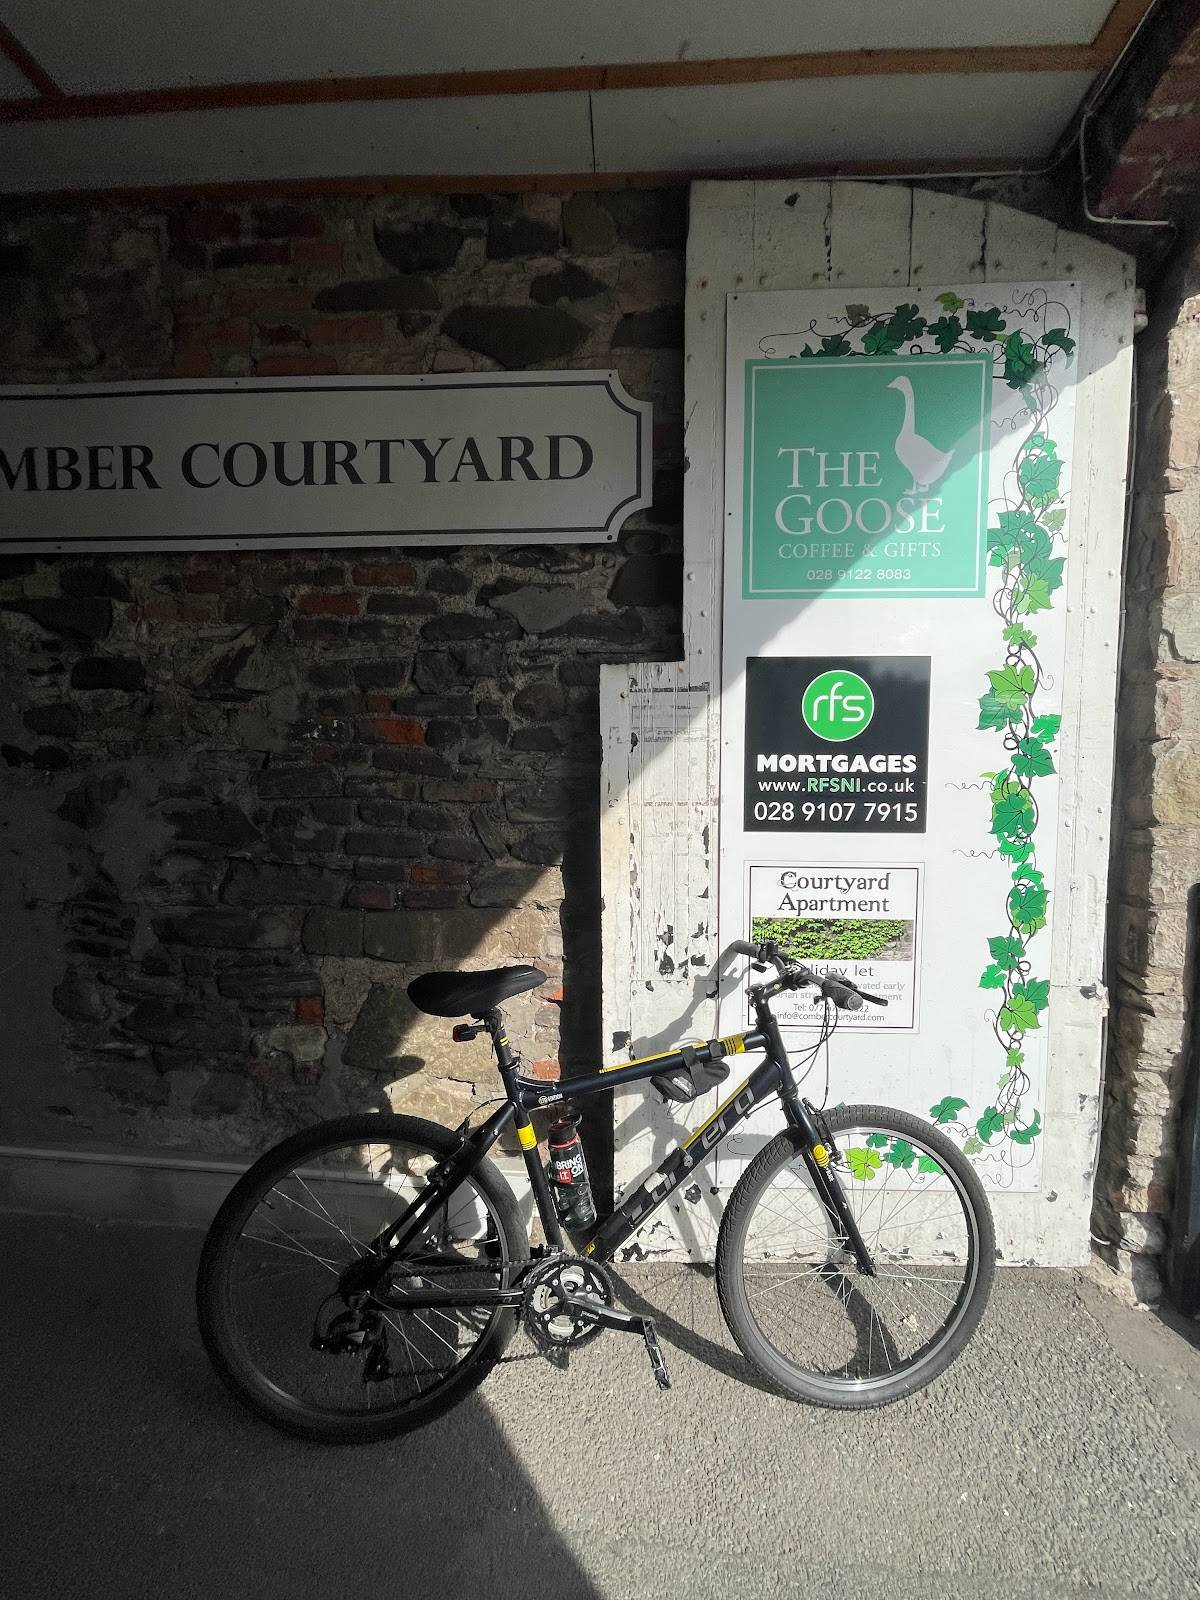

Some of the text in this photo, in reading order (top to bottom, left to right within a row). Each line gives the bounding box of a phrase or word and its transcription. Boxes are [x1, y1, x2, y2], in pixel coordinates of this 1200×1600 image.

[180, 434, 594, 490] COURTYARD
[777, 446, 883, 488] THE
[774, 494, 945, 535] GOOSE
[778, 541, 942, 559] COFFEE & GIFTS
[807, 568, 912, 580] 028 9122 8083
[812, 681, 865, 722] rfs
[756, 754, 917, 773] MORTGAGES
[757, 777, 915, 793] www.RFSNI.co.uk
[754, 802, 918, 822] 028 9107 7915
[778, 871, 891, 894] Courtyard
[777, 892, 890, 916] Apartment
[854, 964, 874, 977] let
[883, 981, 906, 991] early
[555, 1153, 582, 1170] BRING
[571, 1161, 584, 1175] ON
